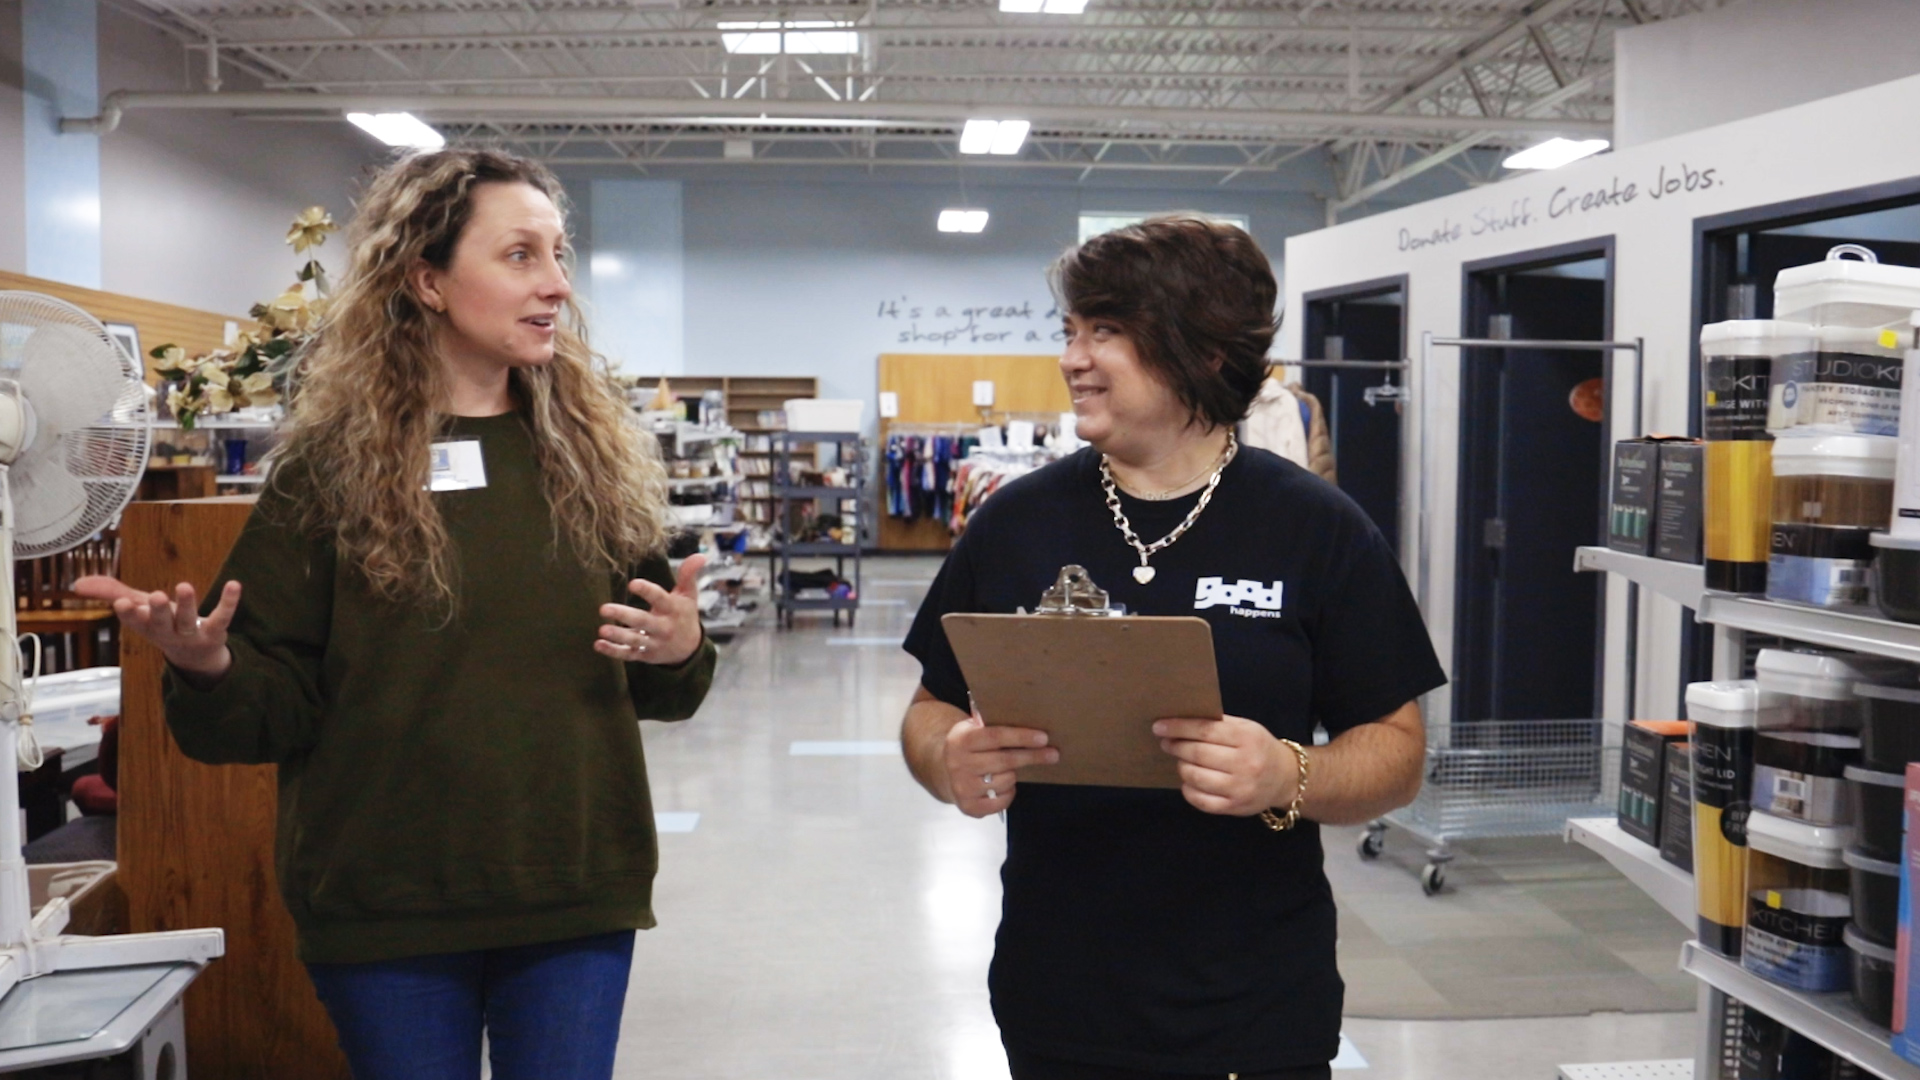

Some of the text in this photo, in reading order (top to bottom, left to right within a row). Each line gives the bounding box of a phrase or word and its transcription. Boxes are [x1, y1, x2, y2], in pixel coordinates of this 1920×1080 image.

[1397, 163, 1724, 252] Donate Stuff. Create Jobs.
[877, 295, 923, 319] It's
[935, 305, 951, 318] a
[955, 301, 1034, 332] great
[897, 322, 957, 346] shop
[968, 324, 1012, 342] for
[1024, 332, 1042, 342] a
[1193, 576, 1284, 610] good
[1229, 604, 1282, 618] happens
[1716, 768, 1736, 780] LID
